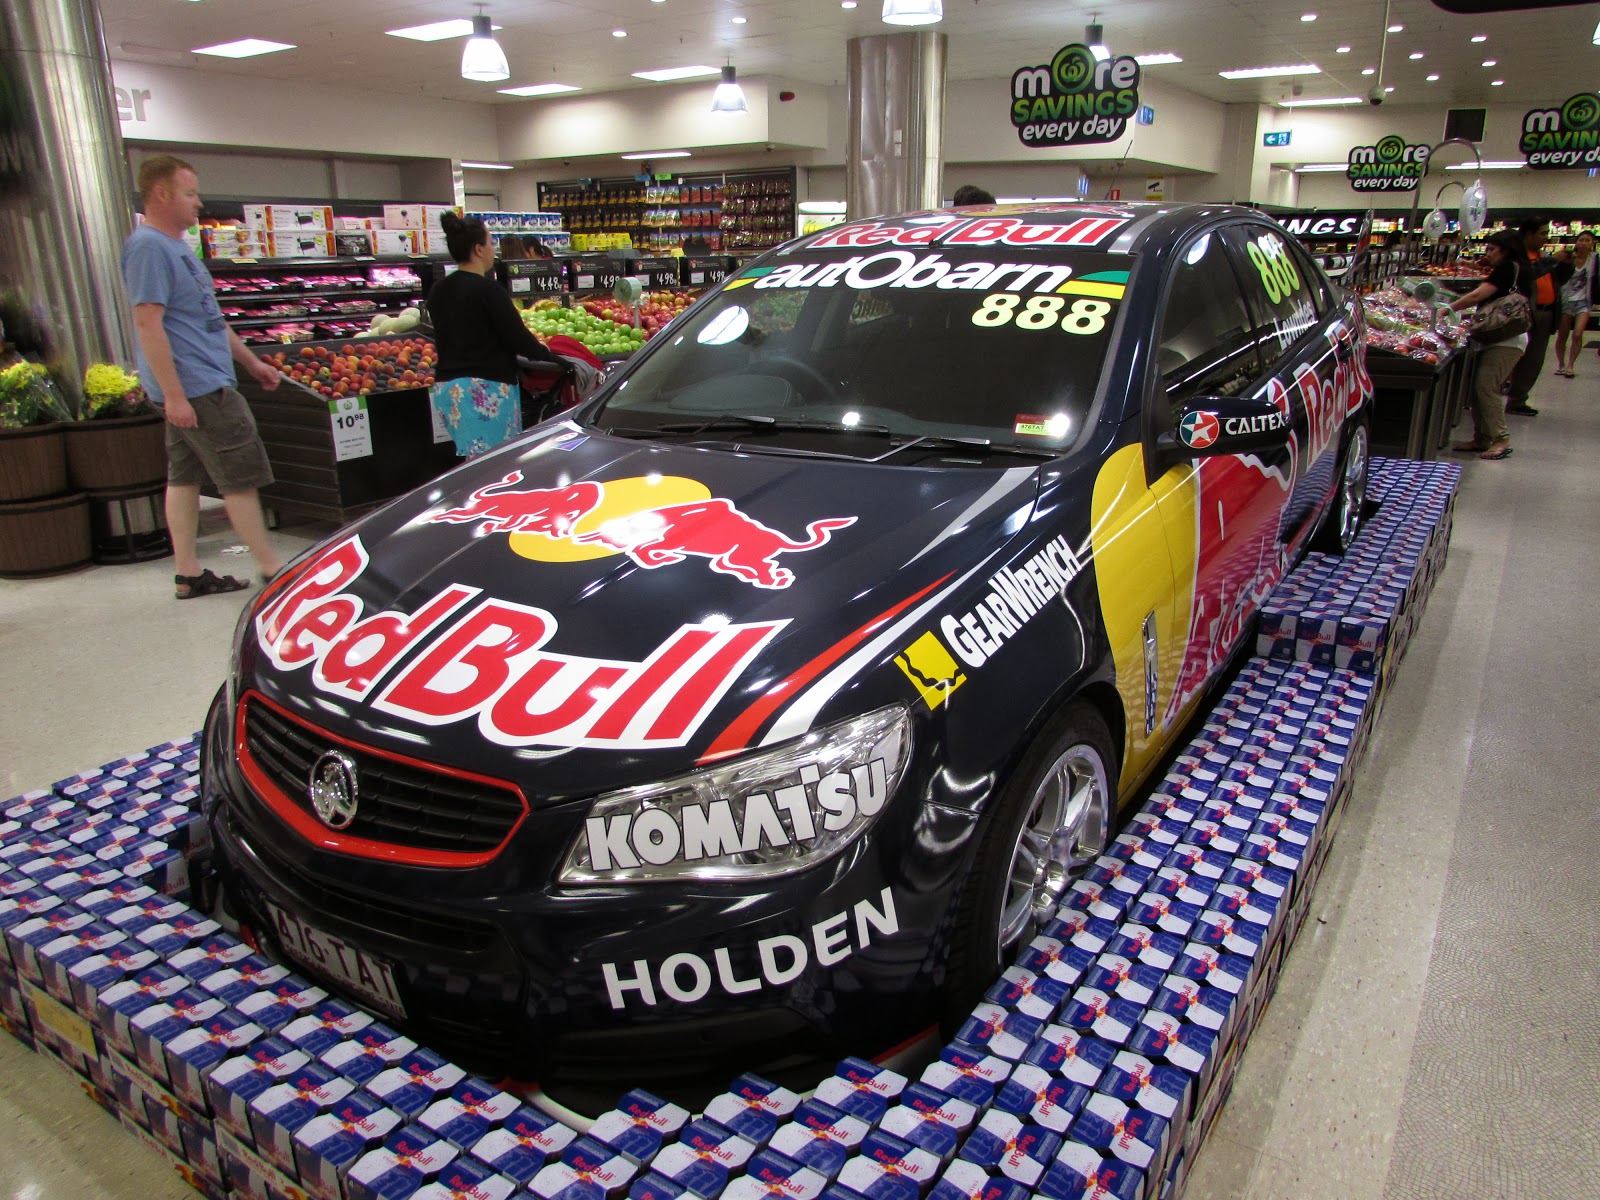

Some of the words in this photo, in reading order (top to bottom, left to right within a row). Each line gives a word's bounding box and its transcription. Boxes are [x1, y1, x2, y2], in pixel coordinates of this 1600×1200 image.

[1014, 90, 1134, 123] SAVINGS
[1022, 120, 1080, 141] every
[1082, 115, 1122, 138] day
[1523, 131, 1600, 151] SAVIN
[1529, 151, 1583, 166] every
[1353, 178, 1391, 190] every
[1393, 176, 1418, 189] day
[972, 294, 1112, 335] 888
[1225, 411, 1286, 436] CALTEX
[585, 757, 888, 872] KOMATSU
[602, 886, 899, 1009] HOLDEN
